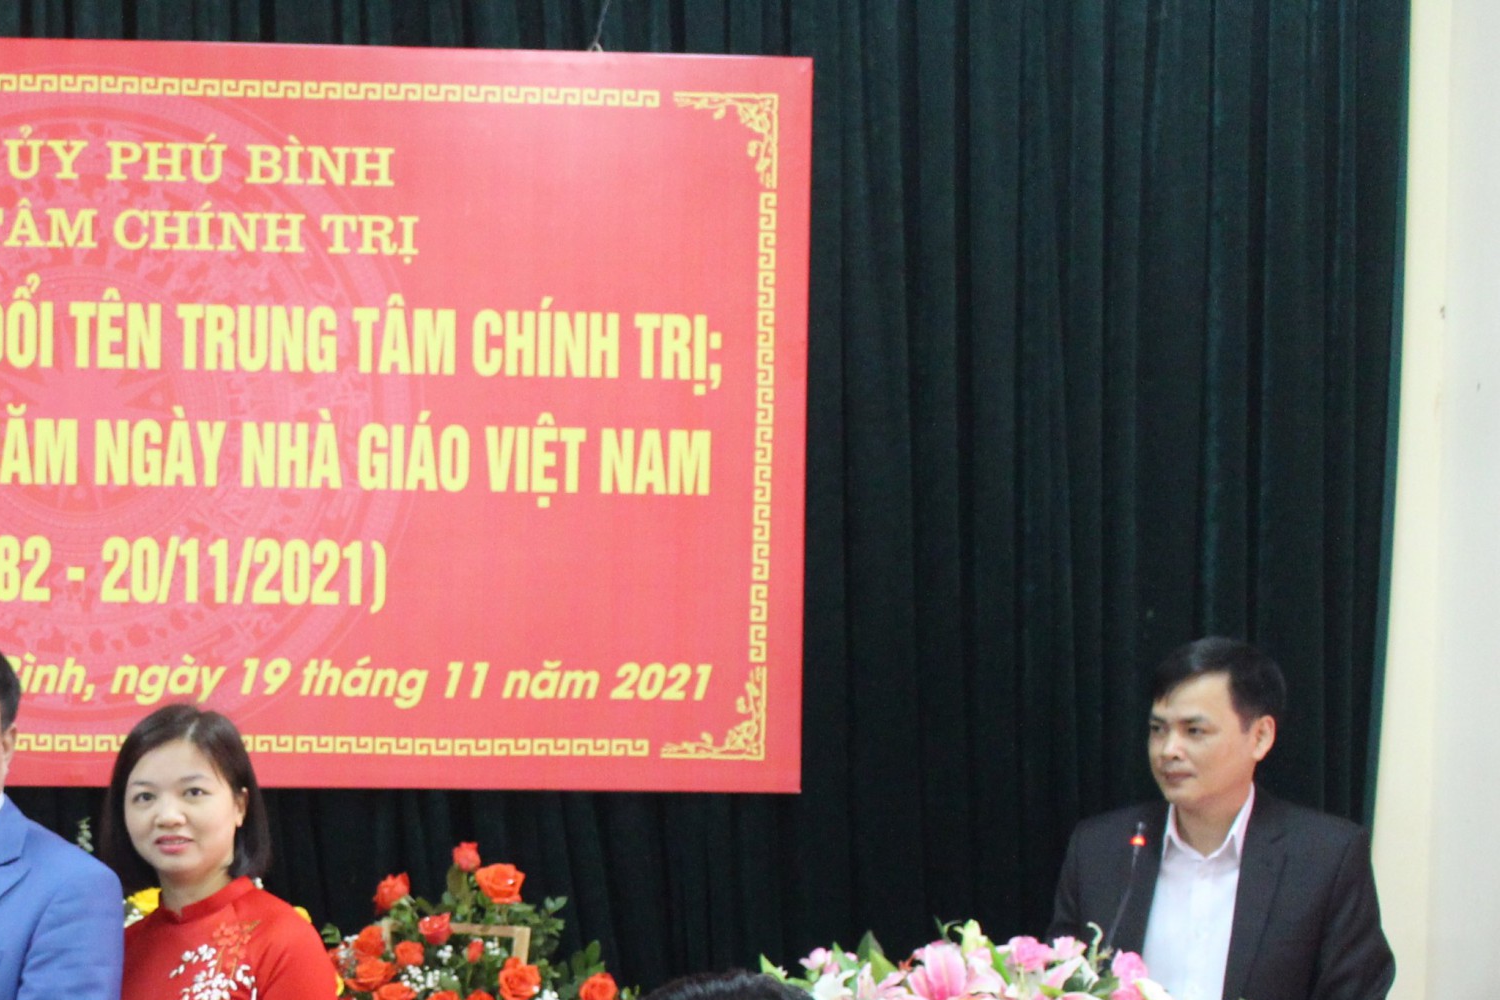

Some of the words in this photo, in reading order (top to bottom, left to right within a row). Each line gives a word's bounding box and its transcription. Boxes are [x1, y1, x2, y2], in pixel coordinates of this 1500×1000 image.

[5, 126, 88, 180] ỦY
[107, 132, 227, 184] PHÚ
[244, 135, 395, 187] BÌNH
[114, 202, 306, 253] CHÍNH
[321, 214, 420, 264] TRỊ
[69, 287, 162, 370] TÊN
[177, 303, 338, 373] TRUNG
[353, 293, 457, 376] TÂM
[473, 297, 621, 379] CHÍNH
[635, 313, 723, 396] TRỊ;
[95, 405, 227, 488] NGÀY
[242, 408, 342, 490] NHÀ
[358, 411, 471, 493] GIÁO
[484, 411, 588, 509] VIỆT
[600, 427, 712, 496] NAM
[67, 566, 86, 582] -
[100, 535, 387, 614] 20/11/2021)
[110, 654, 226, 706] ngày
[242, 657, 292, 696] 19
[300, 655, 429, 710] tháng
[444, 661, 490, 699] 11
[502, 660, 600, 700] năm
[610, 662, 713, 701] 2021
